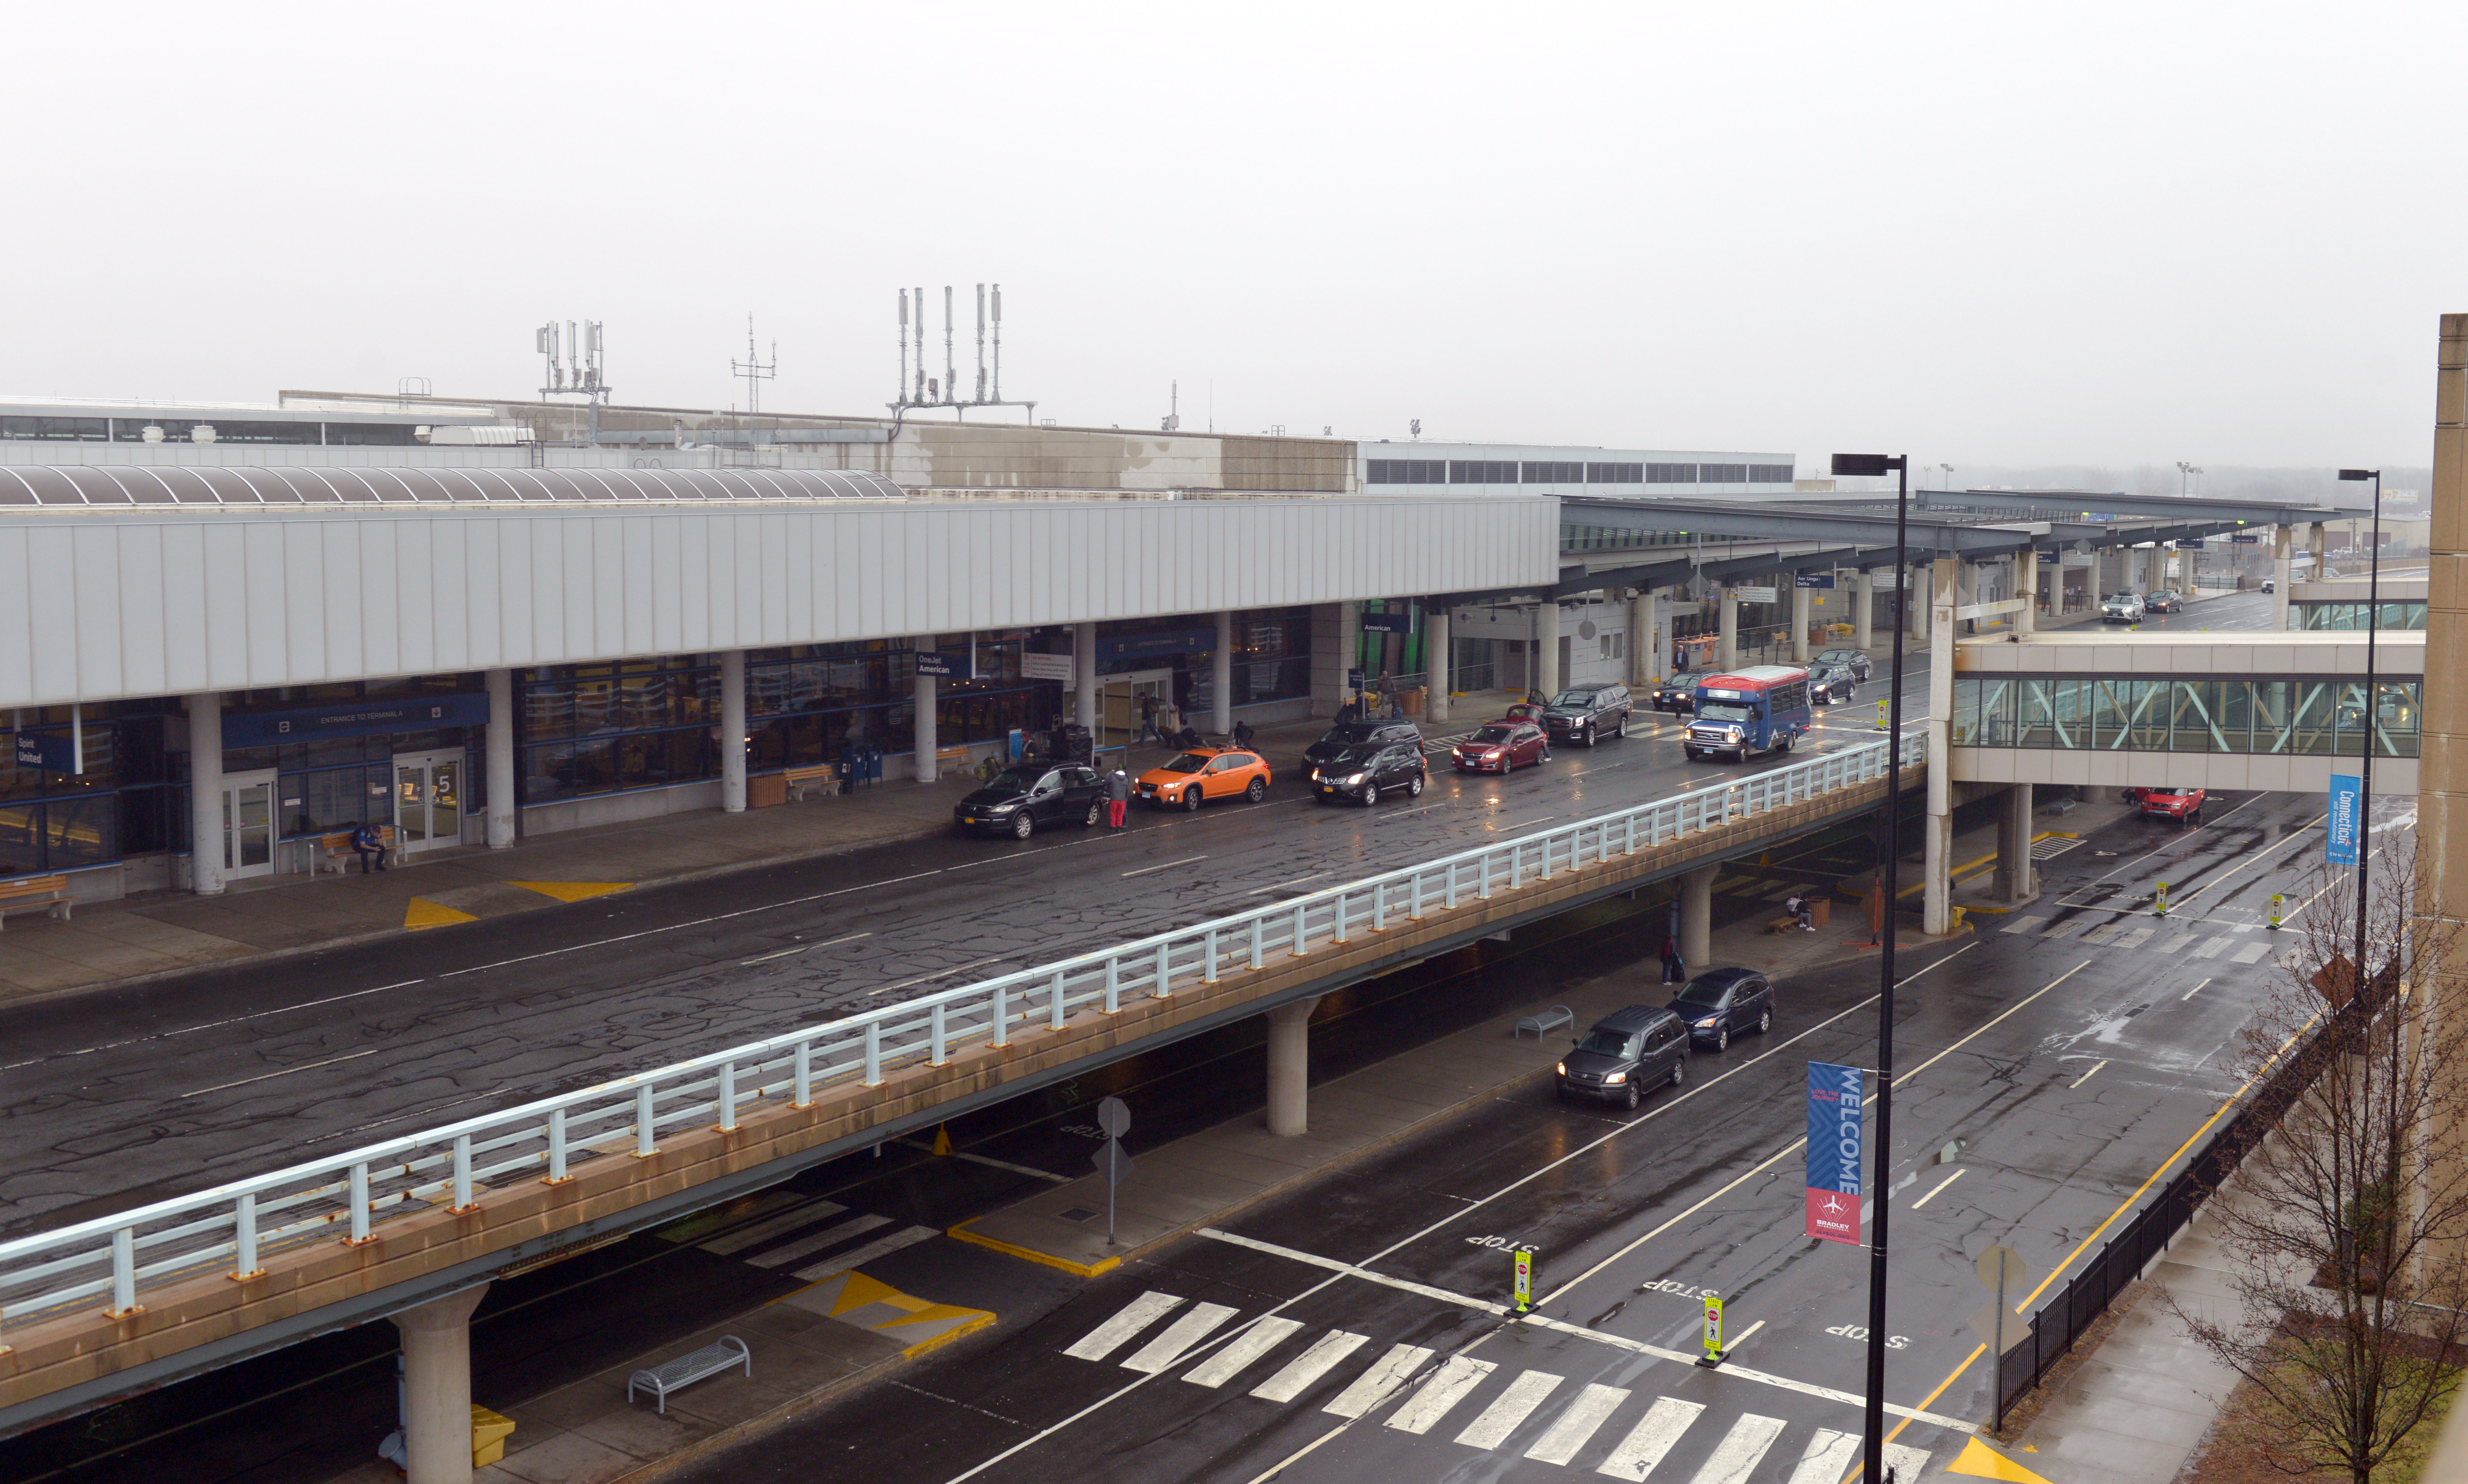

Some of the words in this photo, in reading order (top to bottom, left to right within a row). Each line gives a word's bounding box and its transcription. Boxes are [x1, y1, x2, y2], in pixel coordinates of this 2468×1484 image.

[919, 656, 941, 664] OneJet
[919, 665, 949, 673] American
[321, 715, 356, 724] ENTRANCE
[367, 711, 397, 720] TERMINAL
[18, 738, 35, 749] Spirit
[19, 751, 42, 764] United
[439, 775, 450, 792] 5
[2337, 791, 2355, 845] Connecticut
[1839, 1069, 1860, 1195] WELCOME
[1816, 1224, 1849, 1232] INTERNATIONAL
[1817, 1219, 1850, 1229] BRADLEY
[1465, 1235, 1540, 1254] STOP
[1825, 1324, 1909, 1348] SOP
